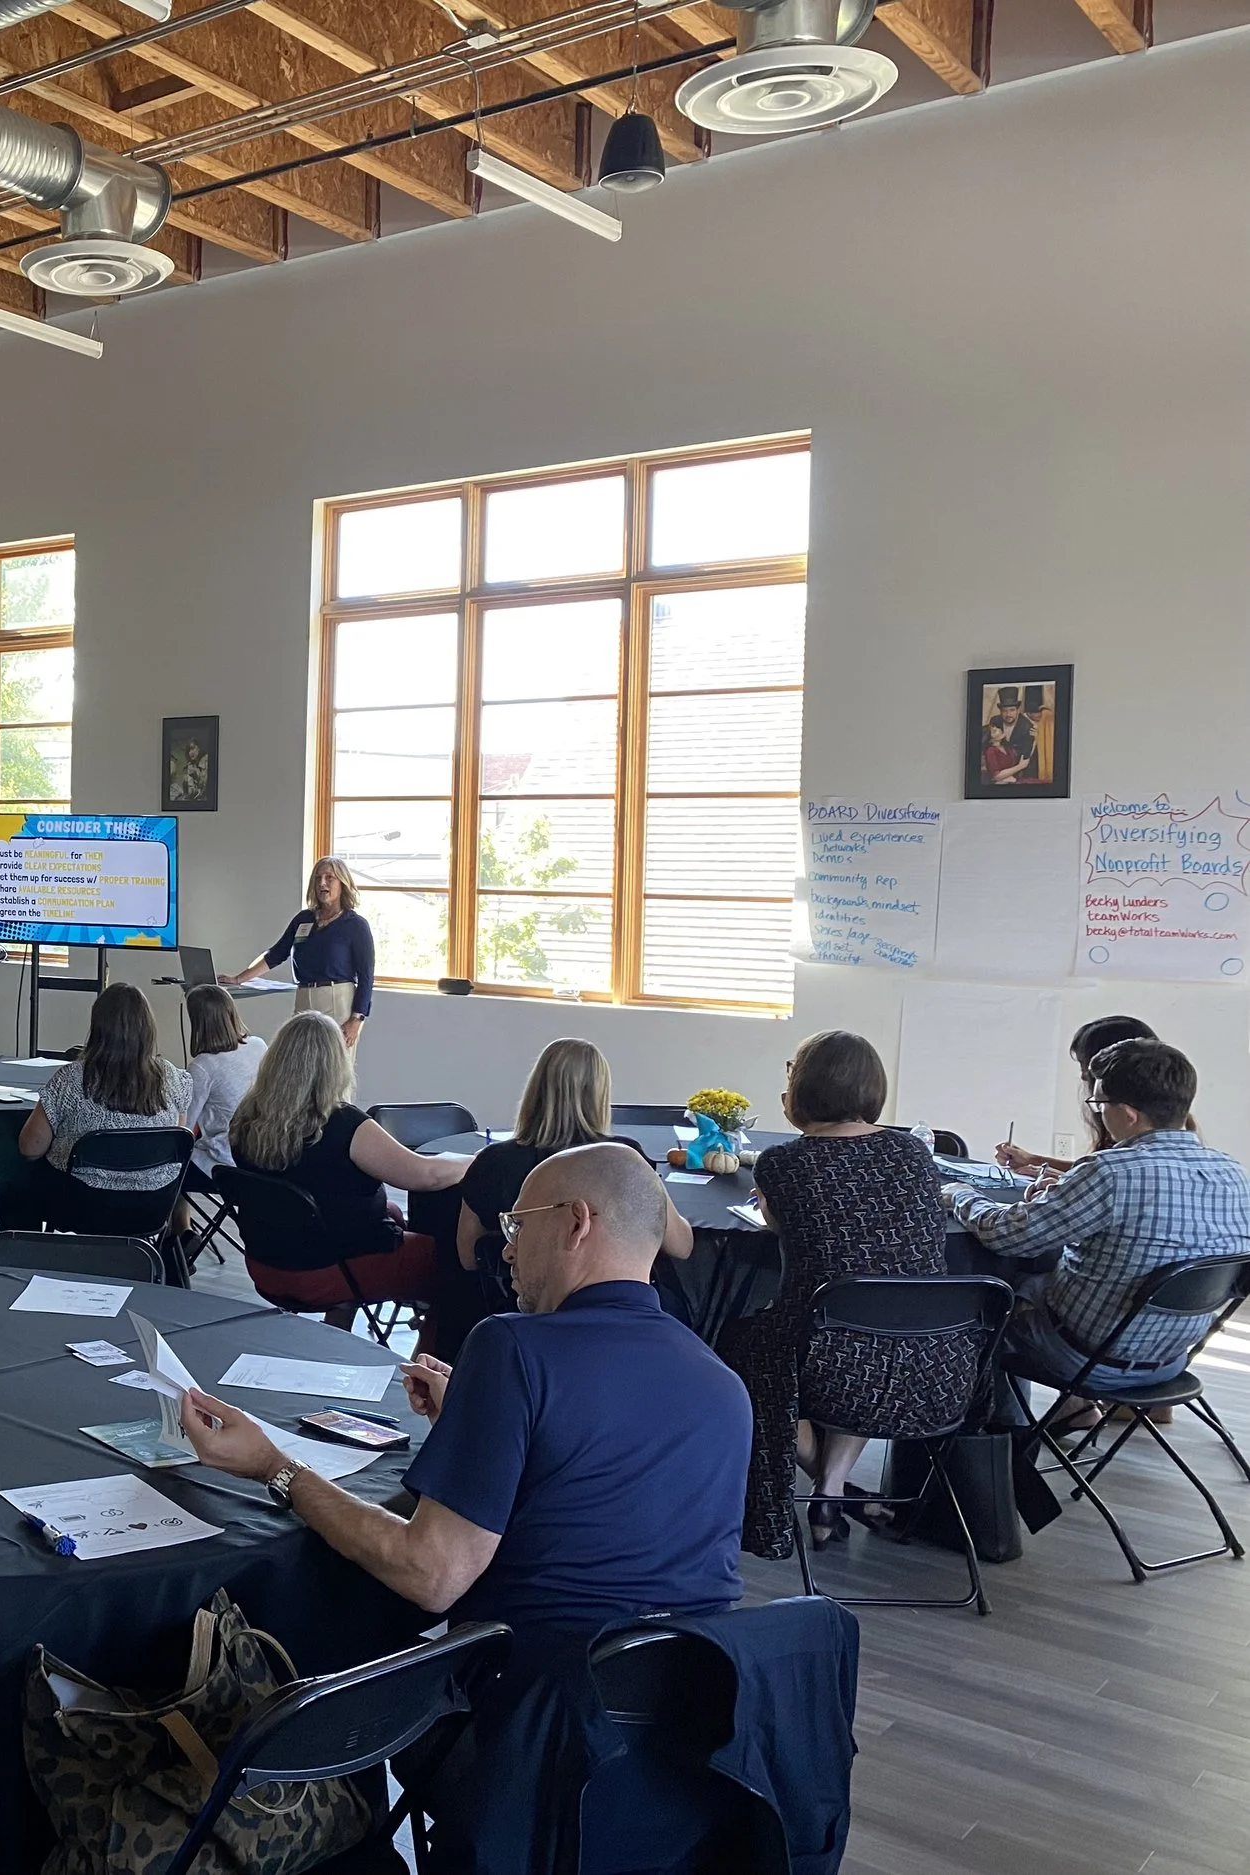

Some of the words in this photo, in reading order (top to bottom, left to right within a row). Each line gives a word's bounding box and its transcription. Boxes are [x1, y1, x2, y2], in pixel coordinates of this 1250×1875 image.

[808, 802, 858, 821] BOARD
[866, 803, 940, 821] Diversification
[37, 820, 101, 833] CONSIDER
[106, 821, 140, 835] THIS:
[812, 830, 844, 845] Lived
[1099, 824, 1222, 851] Diversifying
[13, 850, 23, 858] be
[24, 850, 69, 859] MEANINGFUL
[70, 851, 82, 859] for
[84, 852, 103, 860] THEM
[24, 862, 47, 871] CLEAR
[49, 863, 102, 871] EXPECTATIONS
[1095, 852, 1170, 875] Nonprofit
[1181, 854, 1243, 873] Boards
[9, 873, 29, 882] them
[30, 875, 39, 884] up
[40, 874, 52, 882] for
[86, 876, 97, 884] w/
[99, 876, 129, 884] PROPER
[131, 877, 166, 886] TRAINING
[18, 886, 56, 894] AVAILABLE
[57, 887, 101, 895] RESOURCES
[37, 898, 94, 907] COMMUNICATION
[96, 900, 115, 908] PLAN
[1085, 894, 1119, 912] Becky
[1123, 896, 1168, 908] Lunders
[28, 909, 41, 917] the
[43, 910, 75, 918] TIMELINE
